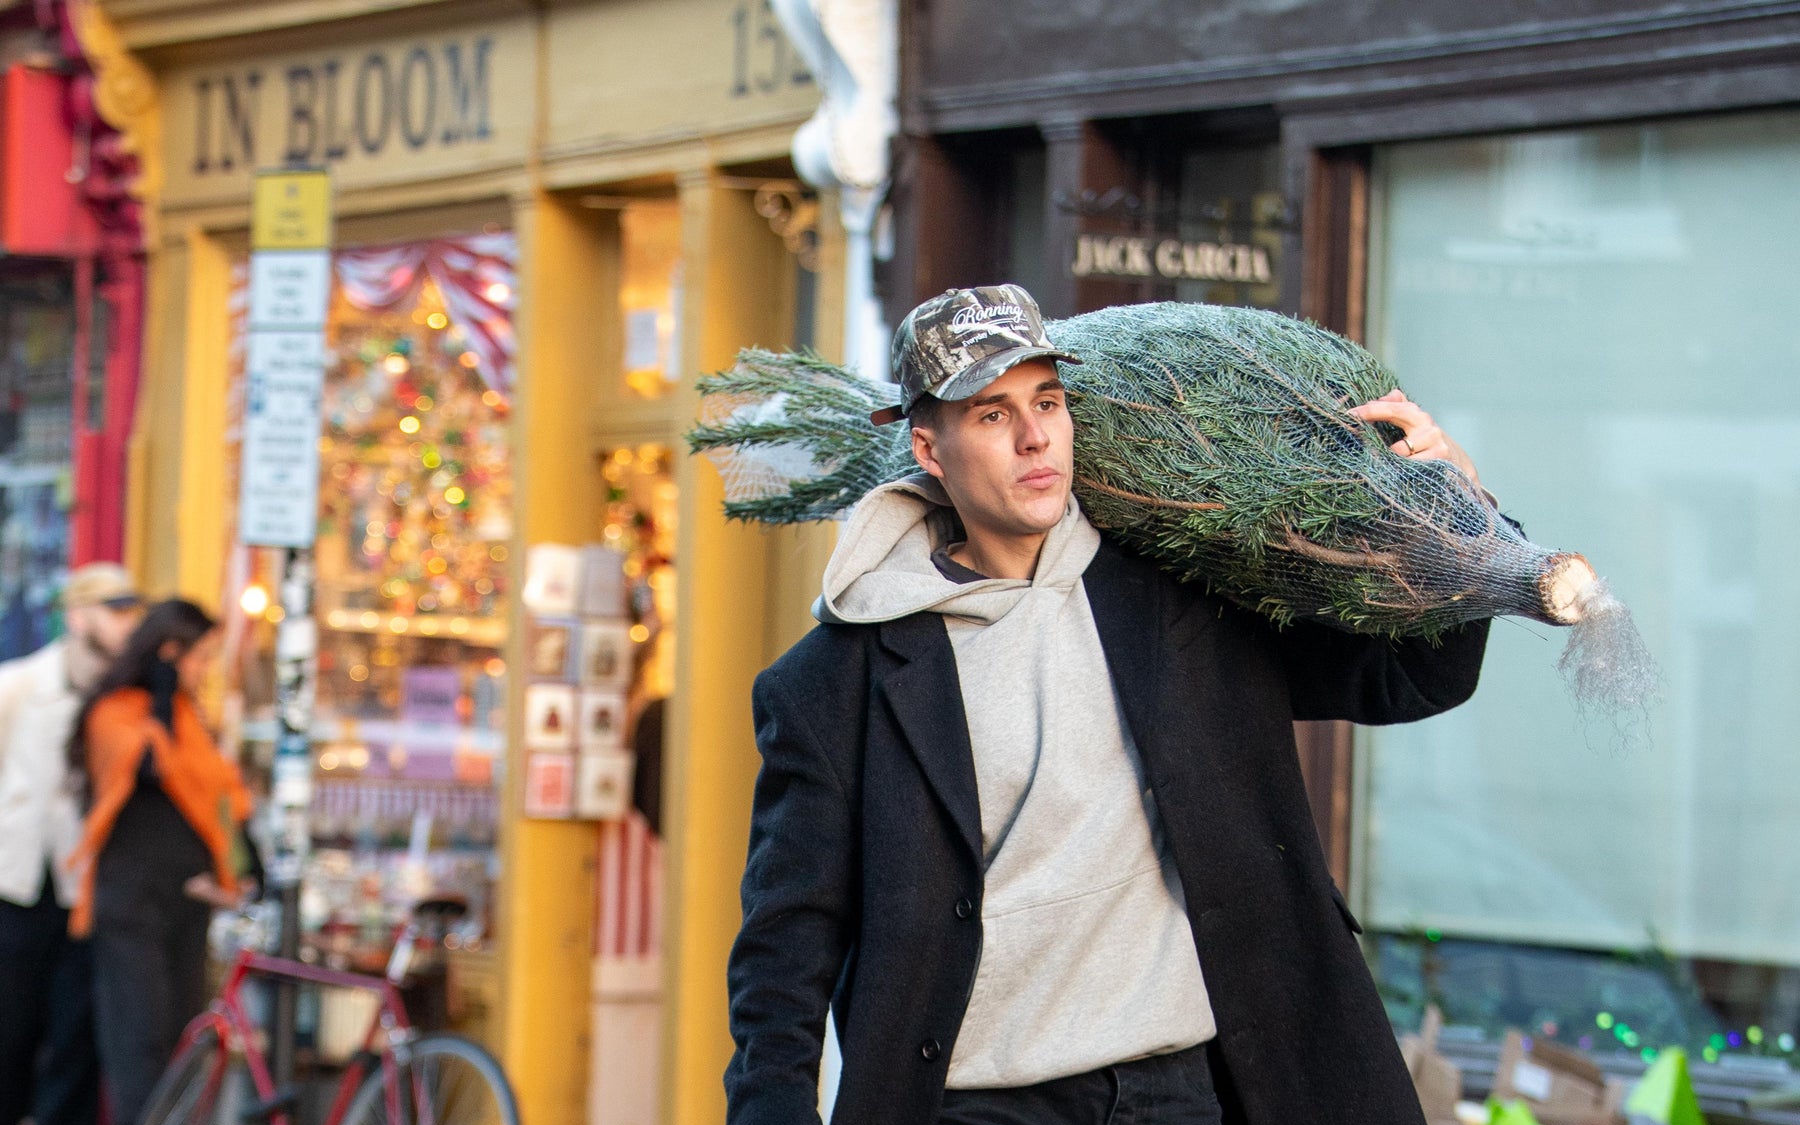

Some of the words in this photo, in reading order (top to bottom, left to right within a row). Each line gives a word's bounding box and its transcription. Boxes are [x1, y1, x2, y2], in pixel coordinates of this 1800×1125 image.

[728, 0, 815, 98] 15
[193, 69, 261, 177] IN
[283, 37, 494, 165] BLOOM
[1071, 234, 1151, 277] JACK
[1155, 239, 1271, 283] GARCIA
[961, 331, 989, 348] Everyday
